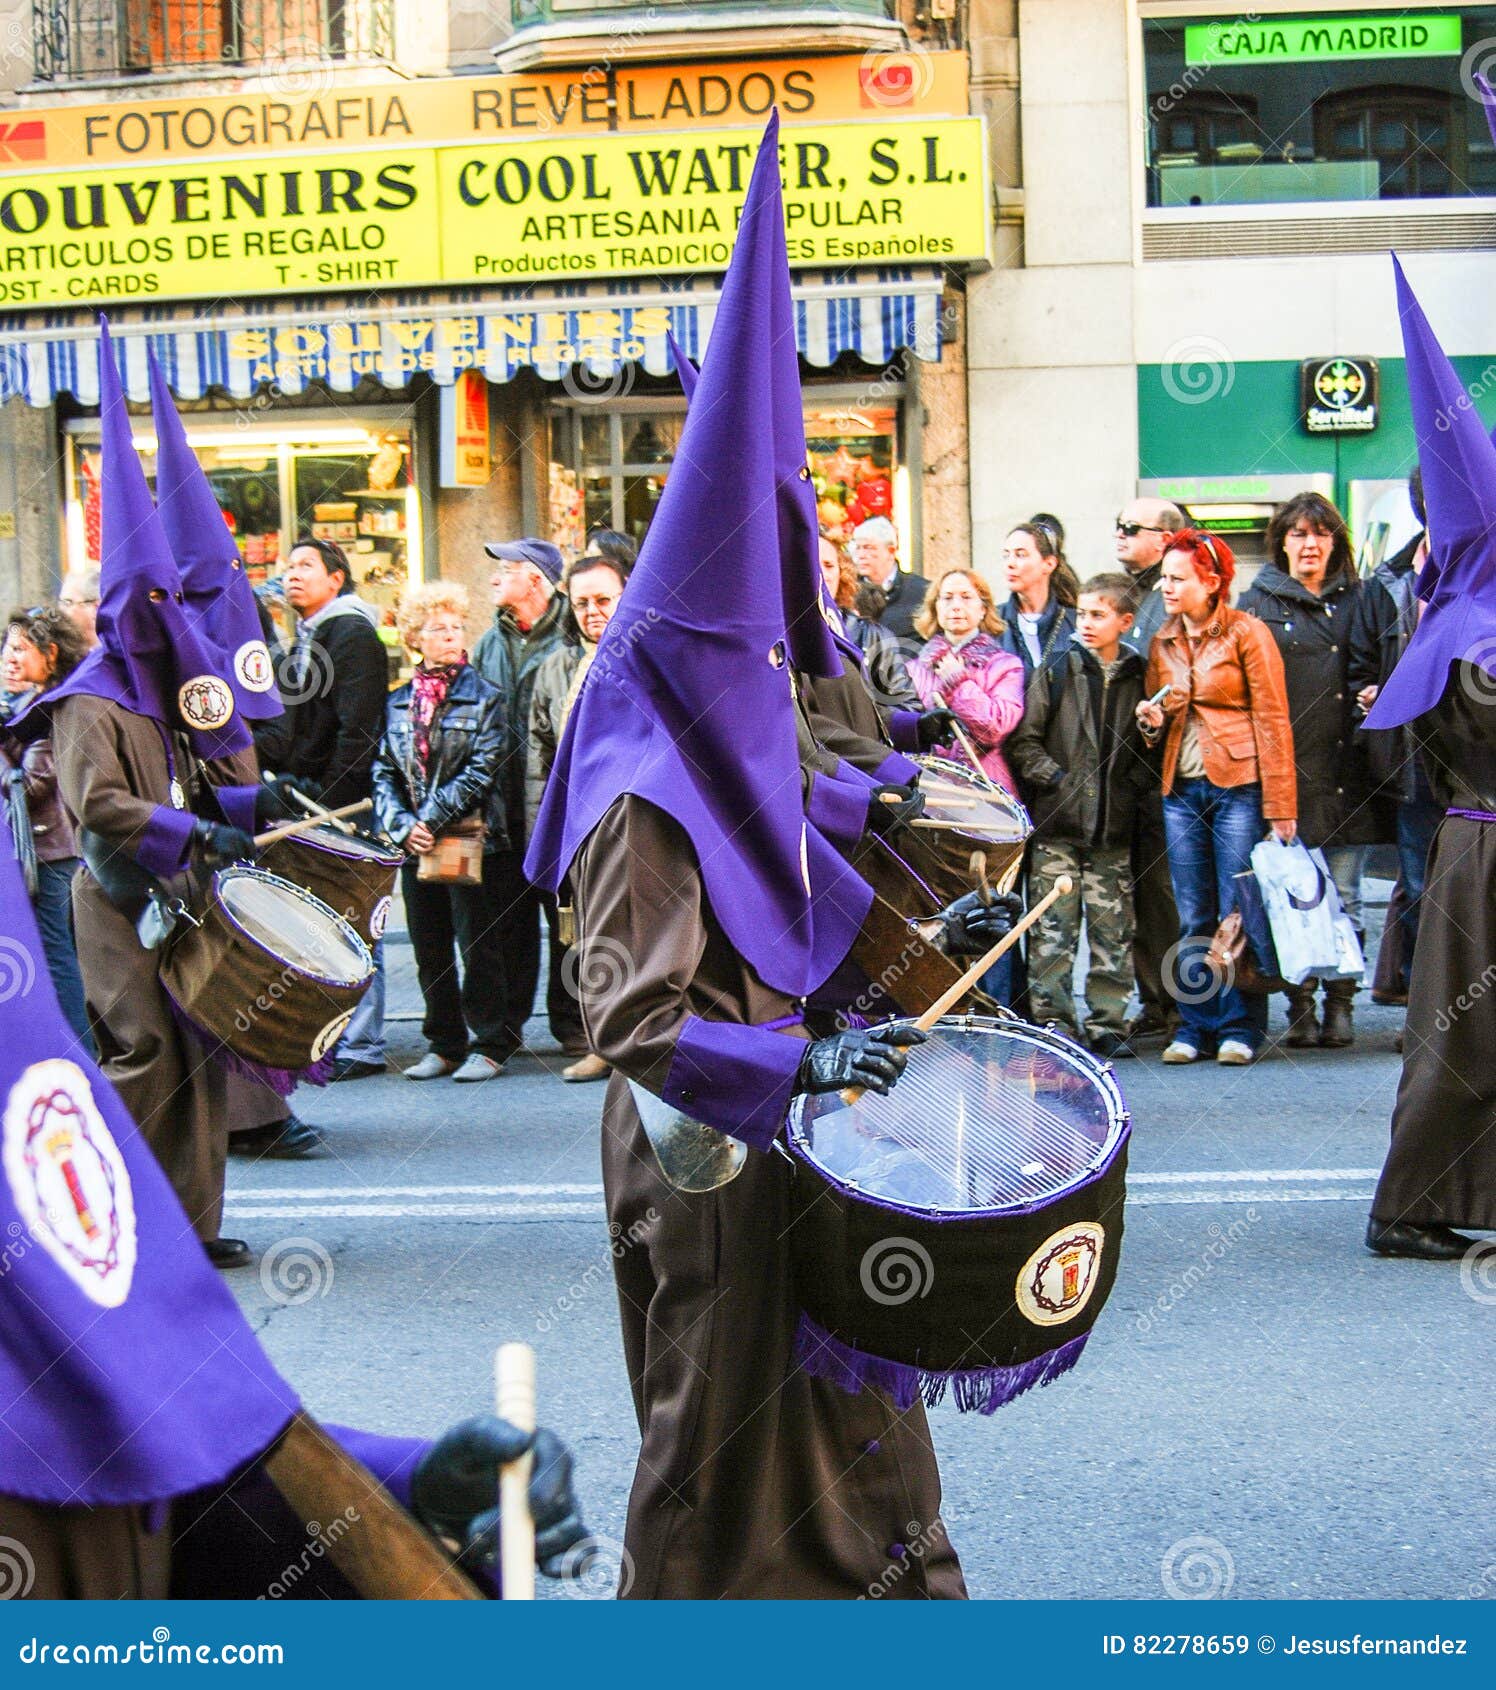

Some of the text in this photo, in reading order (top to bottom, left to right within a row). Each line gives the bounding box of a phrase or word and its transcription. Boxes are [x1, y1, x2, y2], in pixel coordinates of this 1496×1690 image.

[1218, 25, 1429, 55] CAJA MADRID
[85, 71, 815, 156] FOTOGRAFIA REVELADOS
[458, 136, 967, 207] COOL WATR, S.L.
[0, 164, 418, 234] OUVENIRS
[521, 199, 902, 242] ARTESANIA PPULAR
[187, 233, 230, 260] DE
[244, 224, 385, 257] REGALO
[475, 234, 954, 273] Productos TRADICIOES Españoles
[0, 280, 42, 301] OST
[67, 273, 159, 297] CARDS
[318, 259, 398, 283] SHIRT
[229, 308, 672, 359] SOUVENIRS
[253, 340, 645, 382] ARTICULOS DE REGALO
